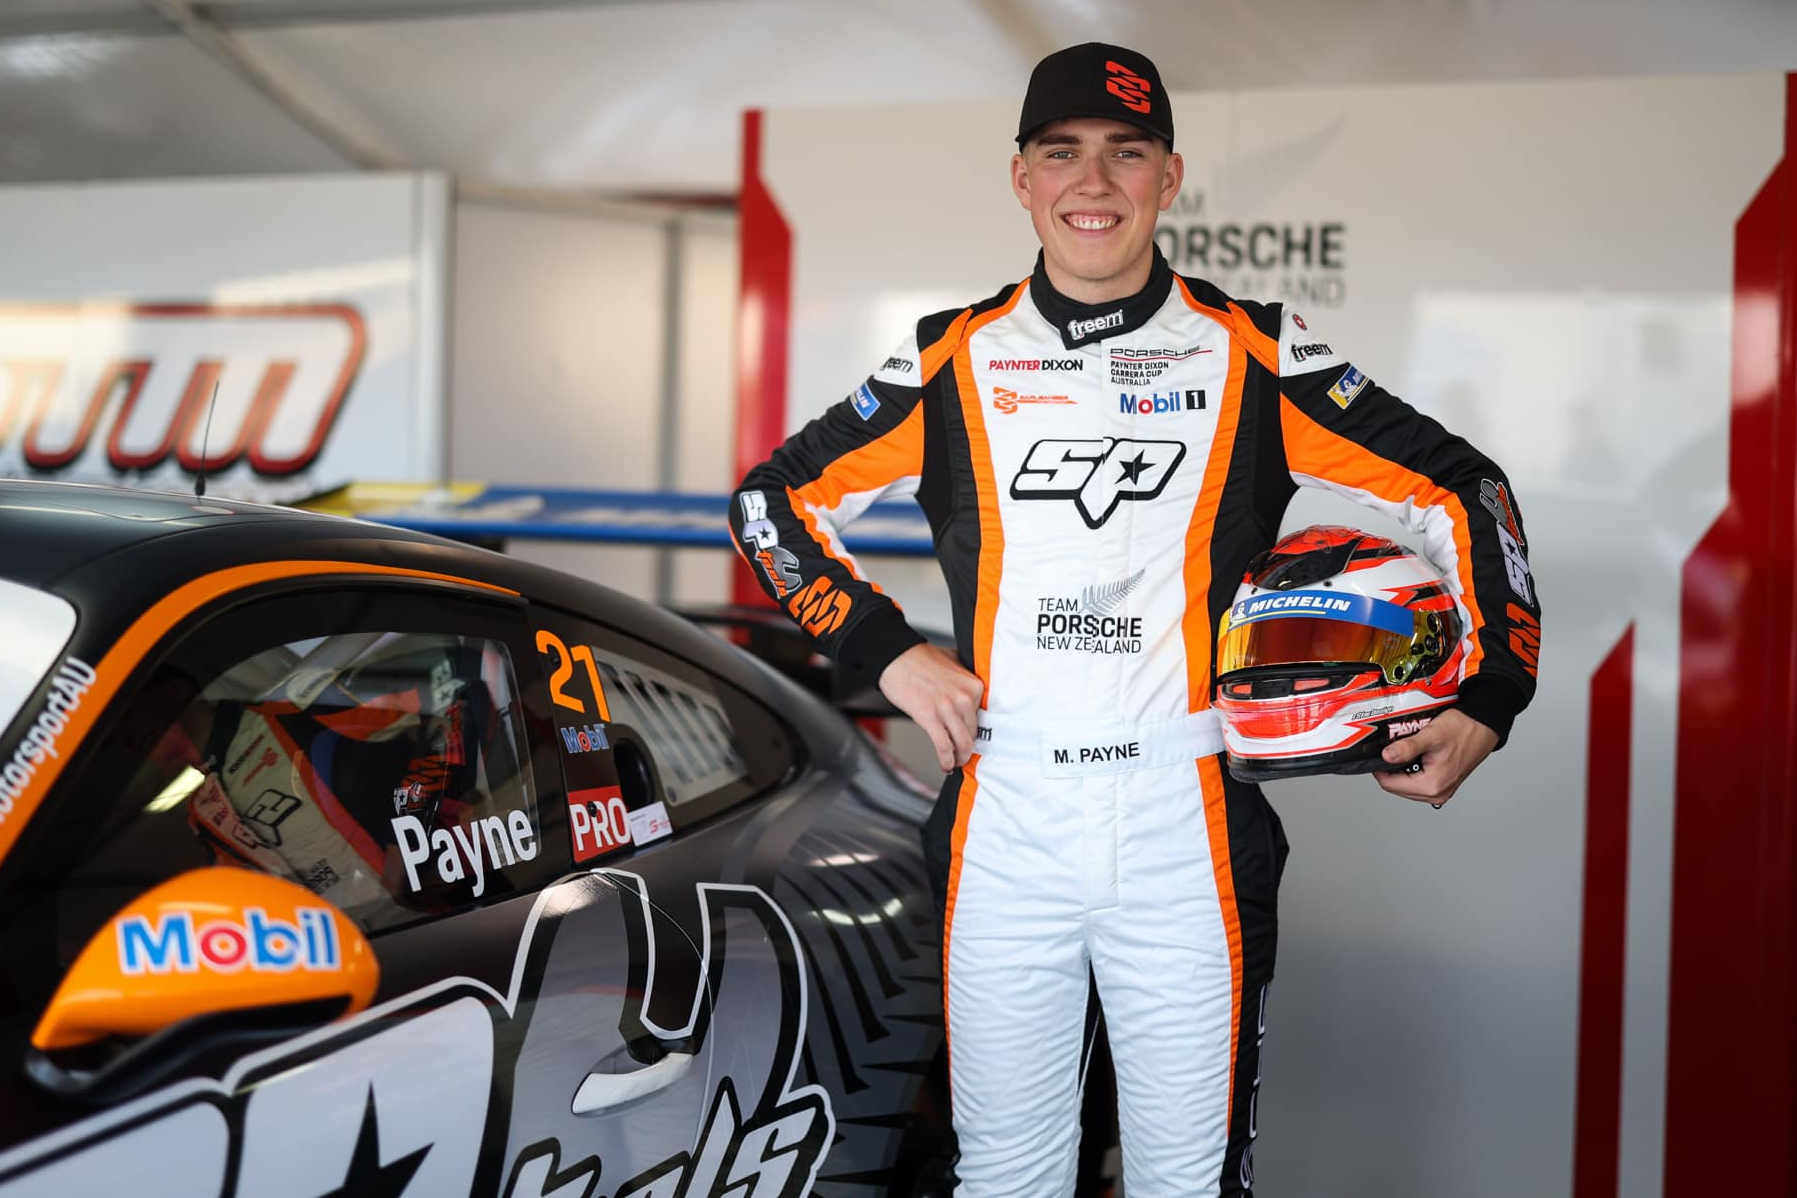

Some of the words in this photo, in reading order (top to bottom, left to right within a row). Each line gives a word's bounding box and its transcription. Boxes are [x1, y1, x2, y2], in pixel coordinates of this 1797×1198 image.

[1154, 222, 1346, 270] ORSCHE
[1067, 309, 1124, 340] freem
[1110, 345, 1200, 357] PORSCHE
[1291, 343, 1334, 362] freem
[1110, 360, 1143, 370] PAYNTER
[1144, 361, 1169, 369] DIXON
[1110, 368, 1144, 378] CARRERA
[1146, 369, 1162, 378] CUP
[1120, 391, 1181, 415] Mobil
[1038, 597, 1078, 612] TEAM
[1248, 595, 1351, 614] MICHELIN
[1037, 613, 1142, 638] PORSCHE
[1037, 636, 1072, 650] NEW
[1074, 636, 1142, 655] ZEALAND
[535, 629, 611, 723] 21
[0, 656, 97, 824] otorsportAU
[560, 723, 610, 754] Mobil
[1054, 750, 1074, 764] M.
[1079, 742, 1140, 764] PAYNE
[569, 797, 632, 851] PRO
[391, 809, 537, 898] Payne
[115, 906, 342, 975] Mobil
